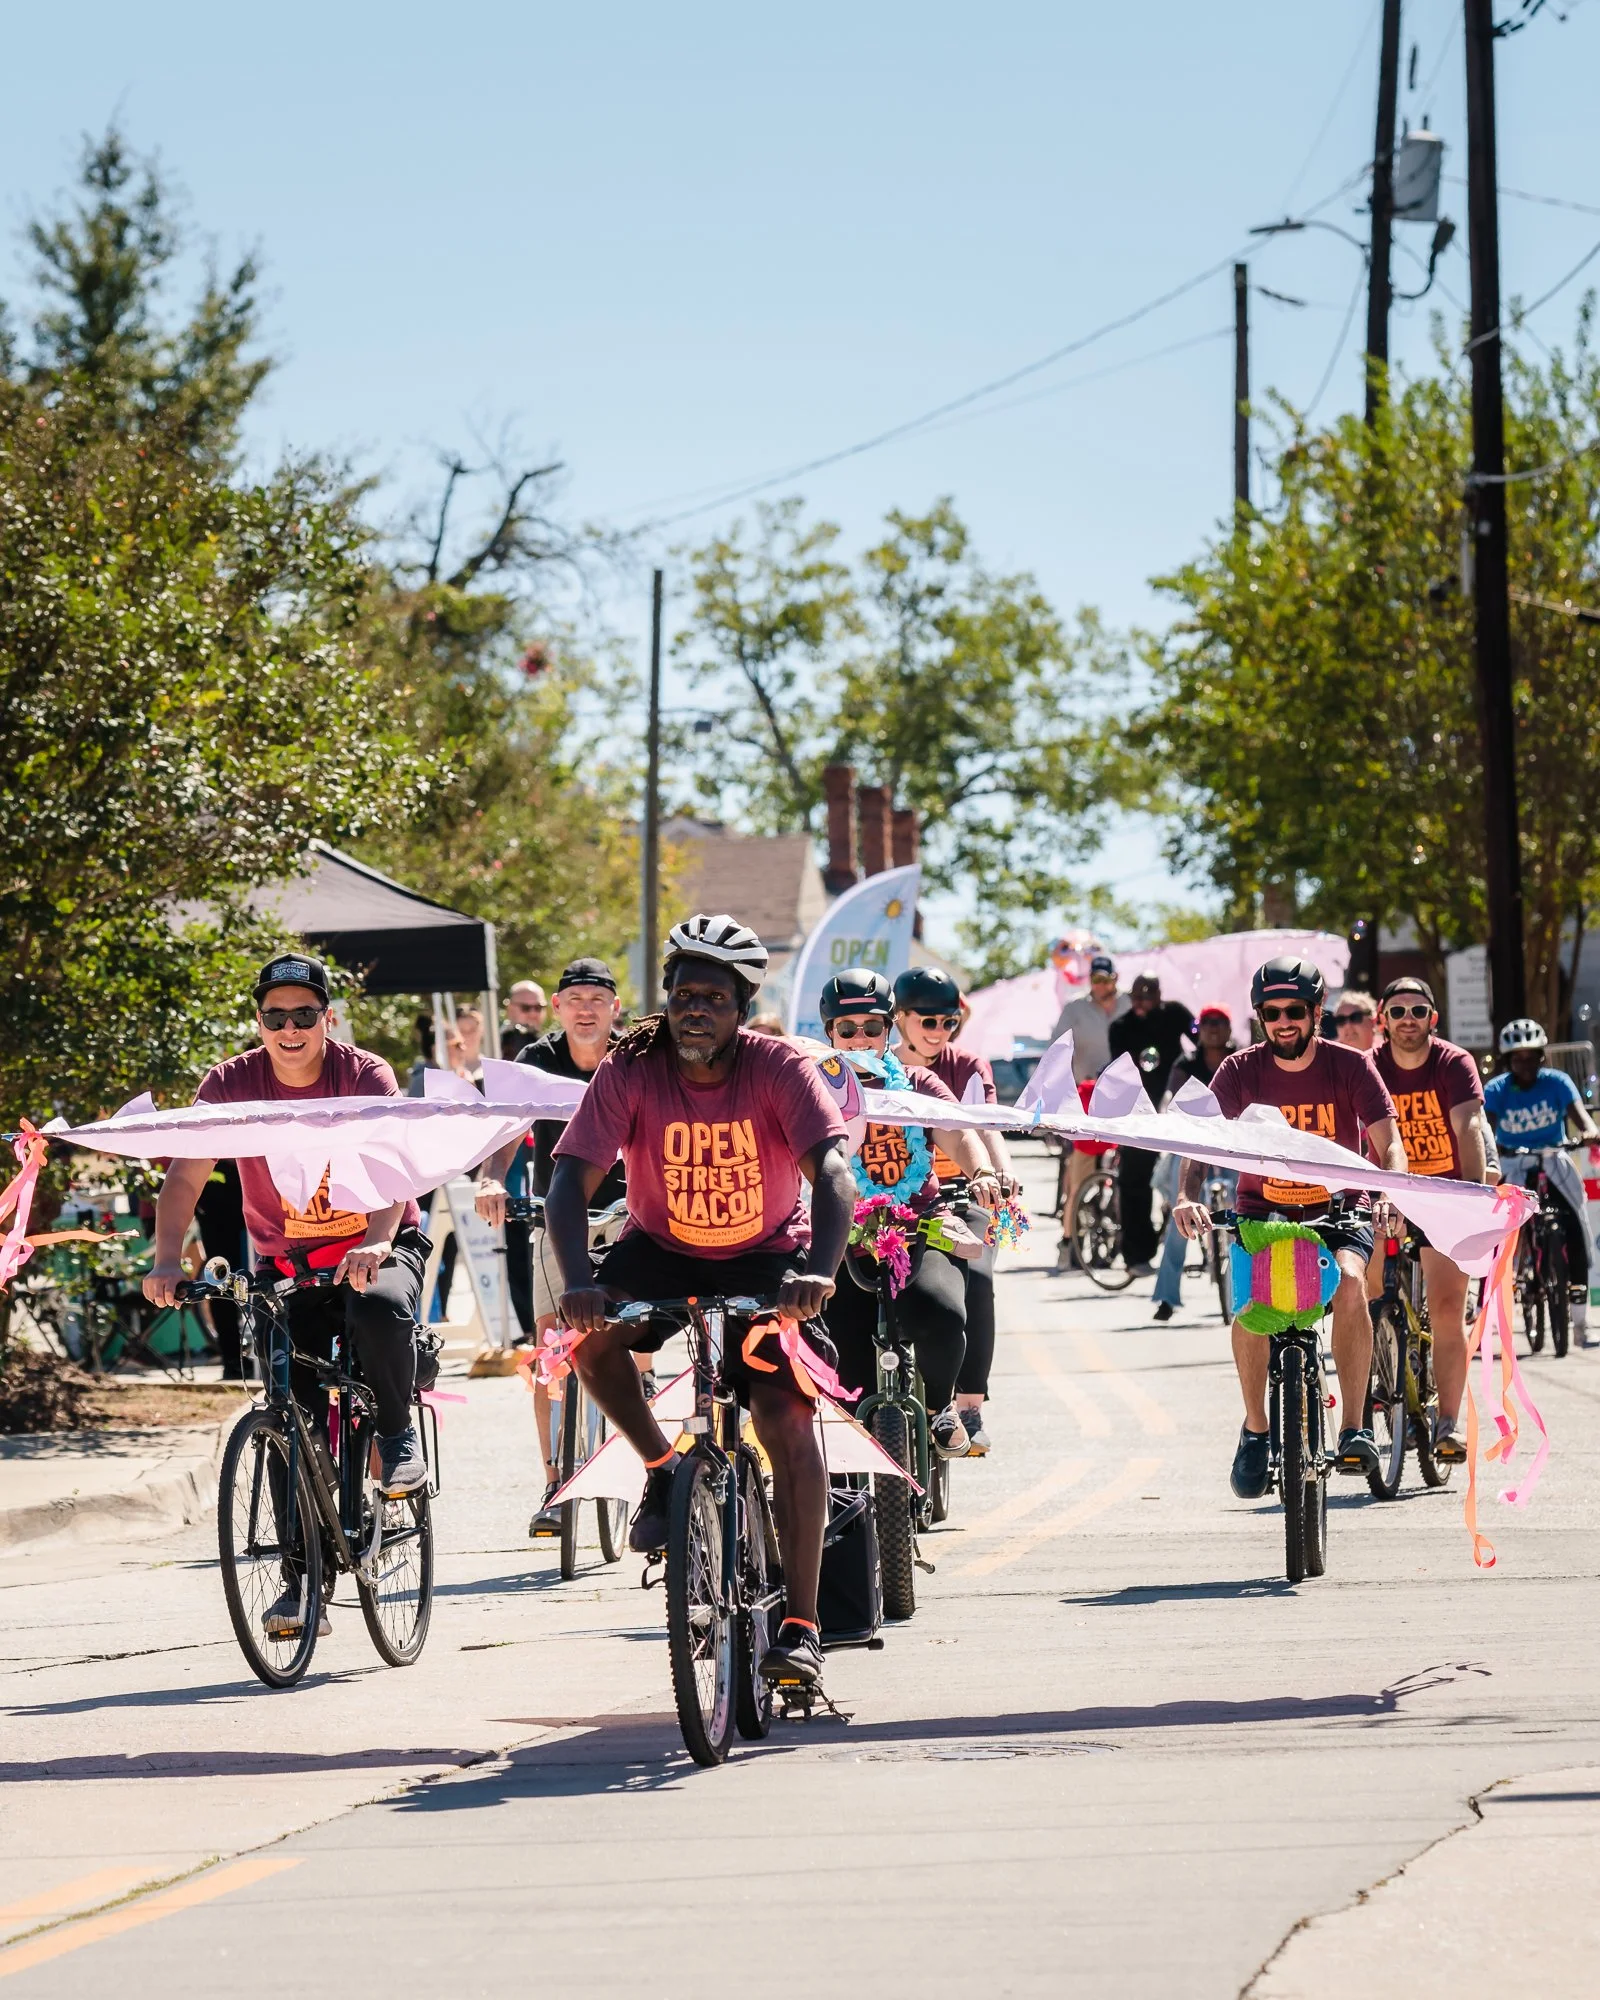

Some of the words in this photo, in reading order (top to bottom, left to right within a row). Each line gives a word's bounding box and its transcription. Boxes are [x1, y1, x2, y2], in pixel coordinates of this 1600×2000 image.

[831, 938, 890, 966] OPEN
[1280, 1103, 1336, 1136] PEN
[664, 1119, 758, 1167] OPEN
[1403, 1134, 1453, 1160] ACON
[664, 1160, 762, 1193] STREETS
[667, 1184, 763, 1227] MACON
[307, 1223, 337, 1231] PLEASANT
[337, 1220, 351, 1228] HILL
[695, 1229, 731, 1237] PLEASANT
[733, 1227, 747, 1235] HILL
